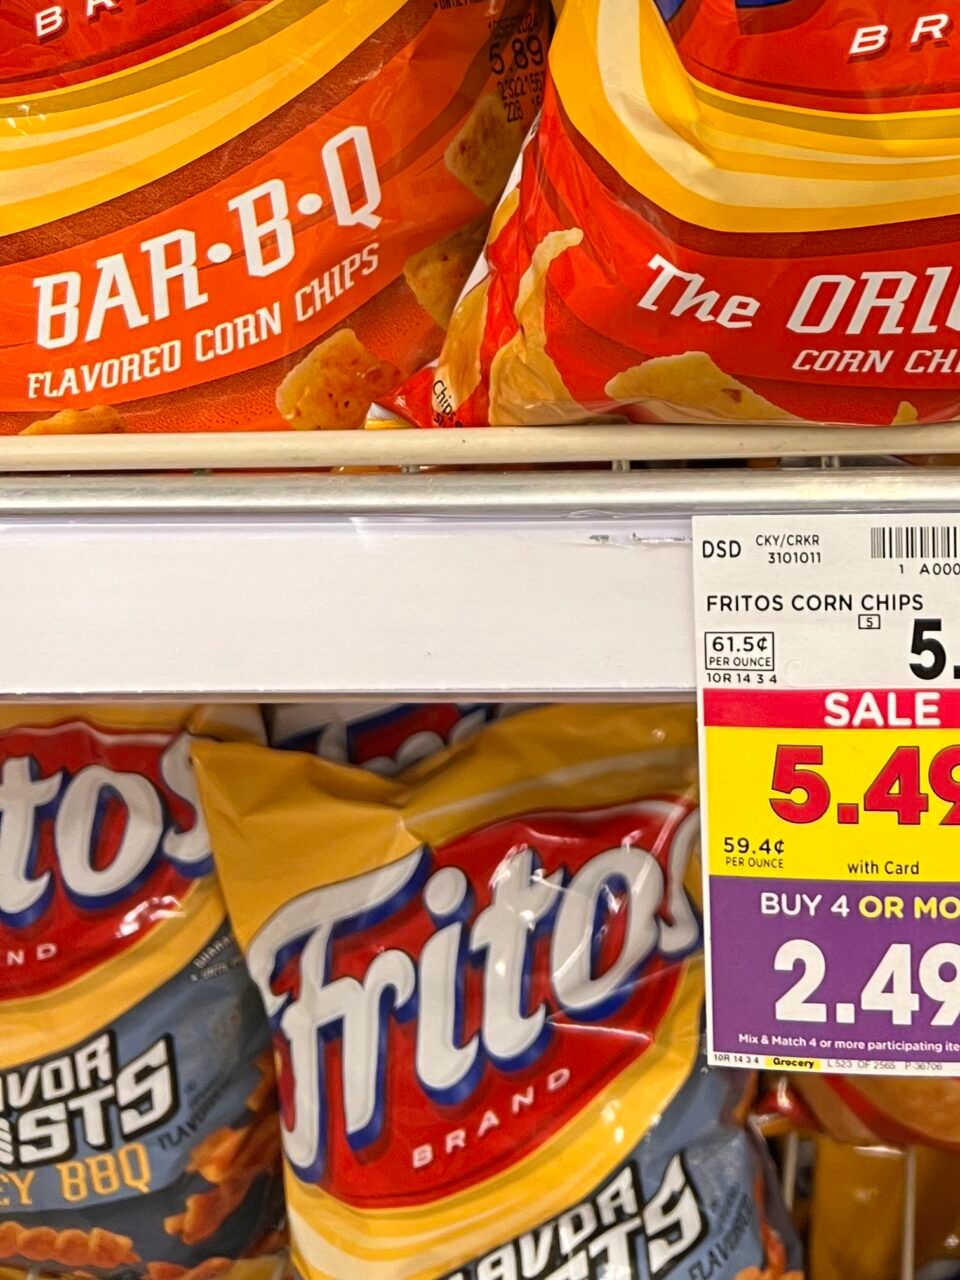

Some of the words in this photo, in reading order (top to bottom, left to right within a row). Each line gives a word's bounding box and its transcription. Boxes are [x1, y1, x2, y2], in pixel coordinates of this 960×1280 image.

[637, 253, 760, 329] The
[27, 338, 181, 399] FLAVORED
[194, 307, 282, 362] CORN
[295, 242, 380, 322] CHIPS
[791, 349, 893, 375] CORN
[702, 540, 742, 559] DSD
[755, 533, 821, 547] CKY/CRKR
[768, 551, 822, 564] 3101011
[706, 594, 784, 612] FRITOS
[792, 594, 853, 612] CORN
[861, 593, 924, 611] CHIPS
[711, 635, 769, 654] 61.5¢
[709, 656, 731, 667] PER
[733, 656, 772, 668] OUNCE
[736, 672, 751, 684] 14
[757, 674, 764, 684] 3
[768, 673, 778, 684] 4
[823, 691, 942, 727] SALE
[723, 836, 785, 855] 59.4¢
[725, 857, 745, 868] PER
[747, 857, 784, 869] OUNCE
[847, 860, 880, 875] with
[884, 860, 920, 876] Card
[760, 891, 823, 916] BUY
[831, 894, 850, 917] 4
[858, 895, 904, 919] OR
[248, 810, 700, 1180] Fritos
[738, 1033, 759, 1045] Mix
[761, 1035, 769, 1045] &
[772, 1035, 806, 1047] Match
[809, 1037, 817, 1047] 4
[819, 1039, 832, 1048] or
[834, 1040, 865, 1050] more
[867, 1040, 943, 1053] participating
[773, 1057, 815, 1069] Grocery
[411, 1066, 570, 1168] BRAND
[55, 1142, 151, 1202] BBQ
